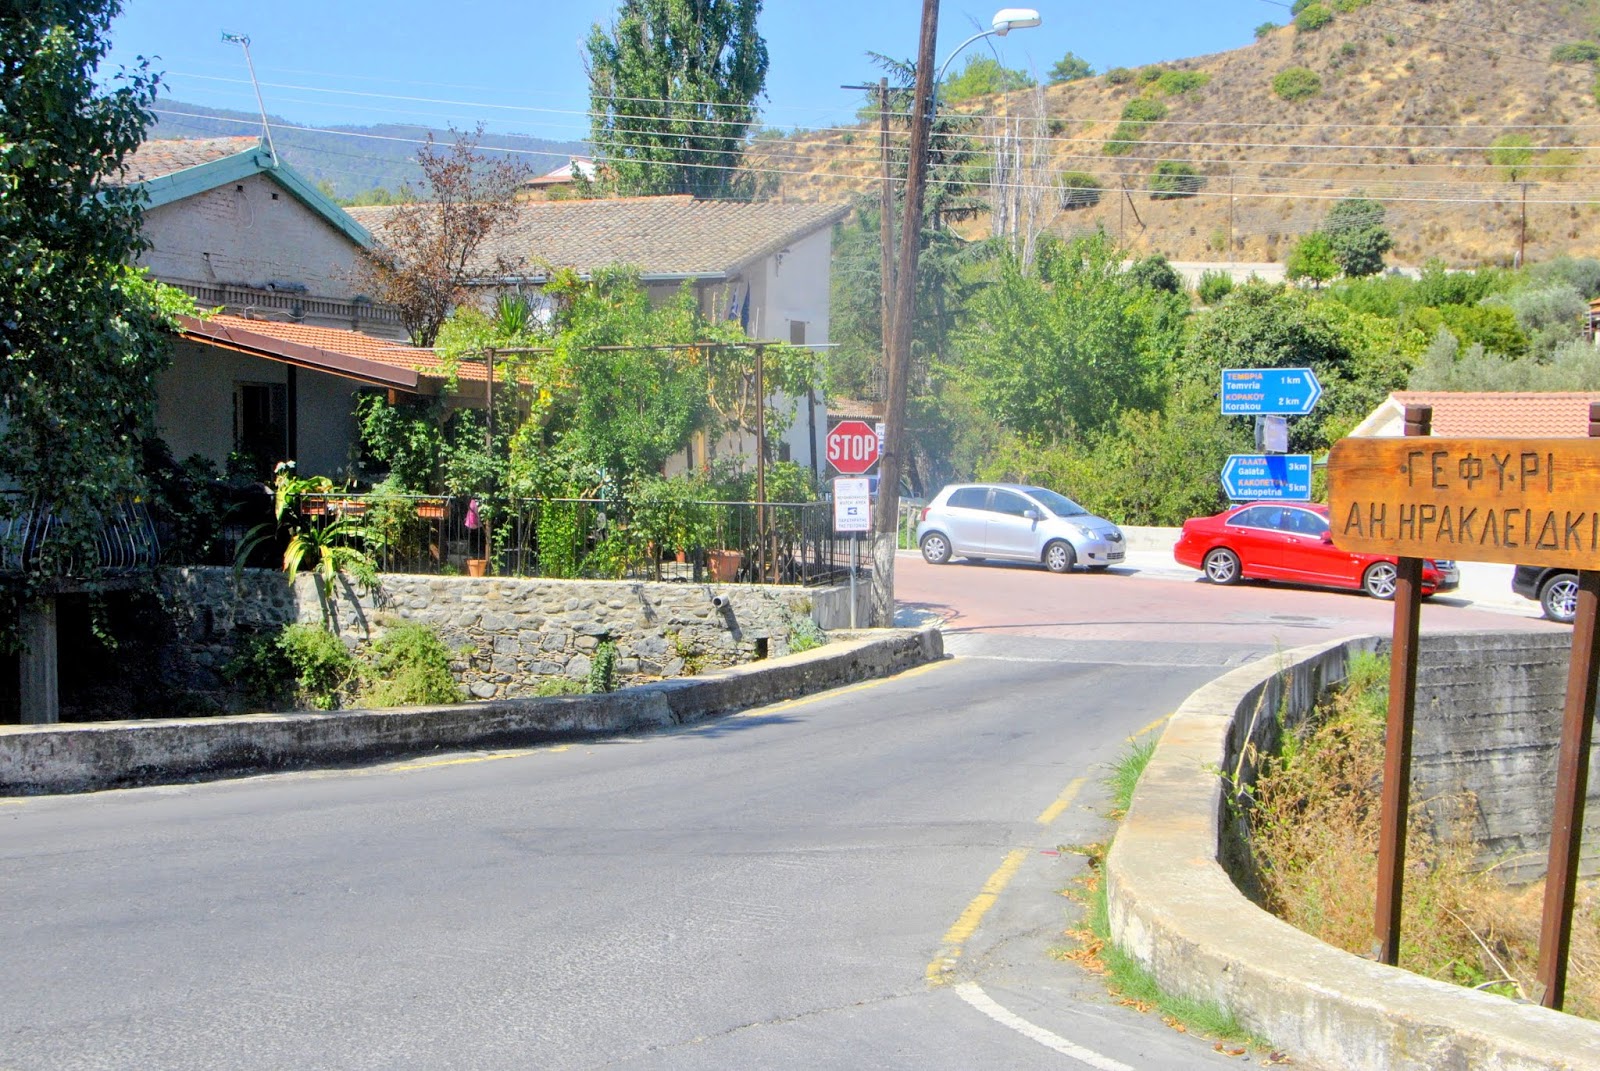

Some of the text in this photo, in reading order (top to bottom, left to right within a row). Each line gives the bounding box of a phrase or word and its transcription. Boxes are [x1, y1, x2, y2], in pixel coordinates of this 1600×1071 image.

[1286, 376, 1301, 384] km
[1226, 381, 1261, 390] Temvria
[1225, 393, 1265, 401] ΚΟΡΑΚΟΥ
[1278, 397, 1300, 406] 2 km
[1225, 402, 1261, 411] Korakou
[829, 434, 875, 461] STOP
[1238, 467, 1265, 476] Galata
[1238, 488, 1283, 497] Kakopetria
